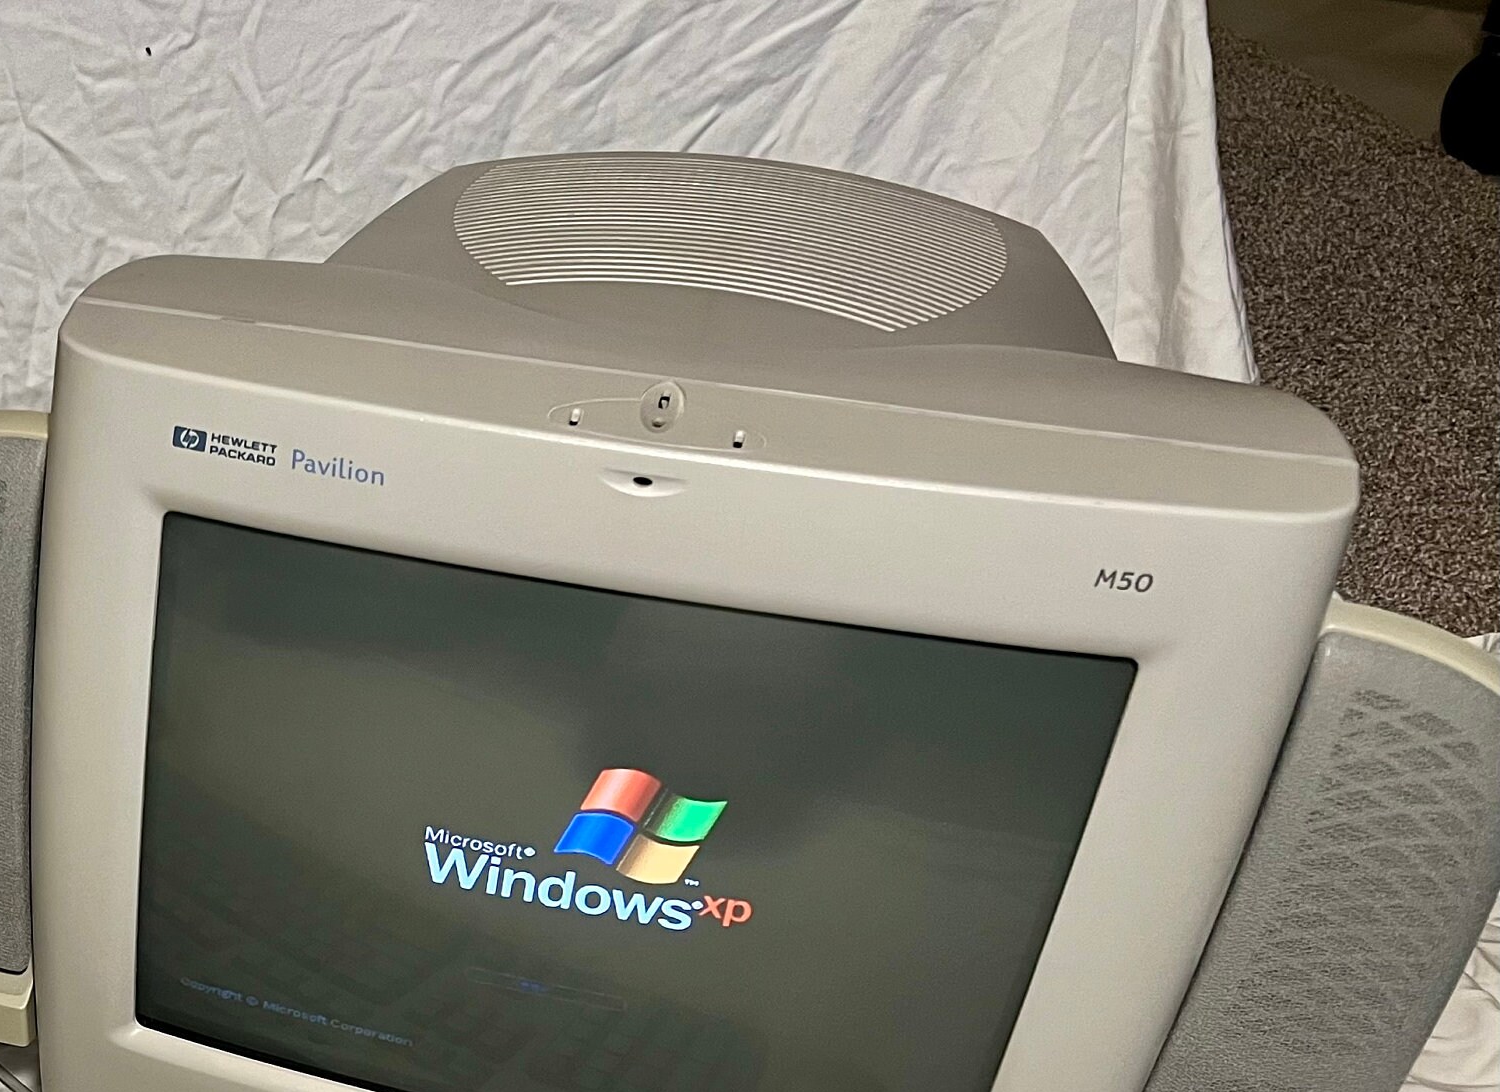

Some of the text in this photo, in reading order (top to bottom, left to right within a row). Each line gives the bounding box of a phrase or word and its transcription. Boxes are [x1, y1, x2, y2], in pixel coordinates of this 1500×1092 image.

[209, 445, 276, 466] PACKARD
[211, 433, 277, 454] HEWLETT
[291, 448, 385, 485] Pavilion
[1094, 569, 1153, 592] M50
[425, 826, 524, 859] Microsoft
[424, 841, 753, 931] Windows xp
[180, 976, 414, 1047] Copyright Microsoft Corporation
